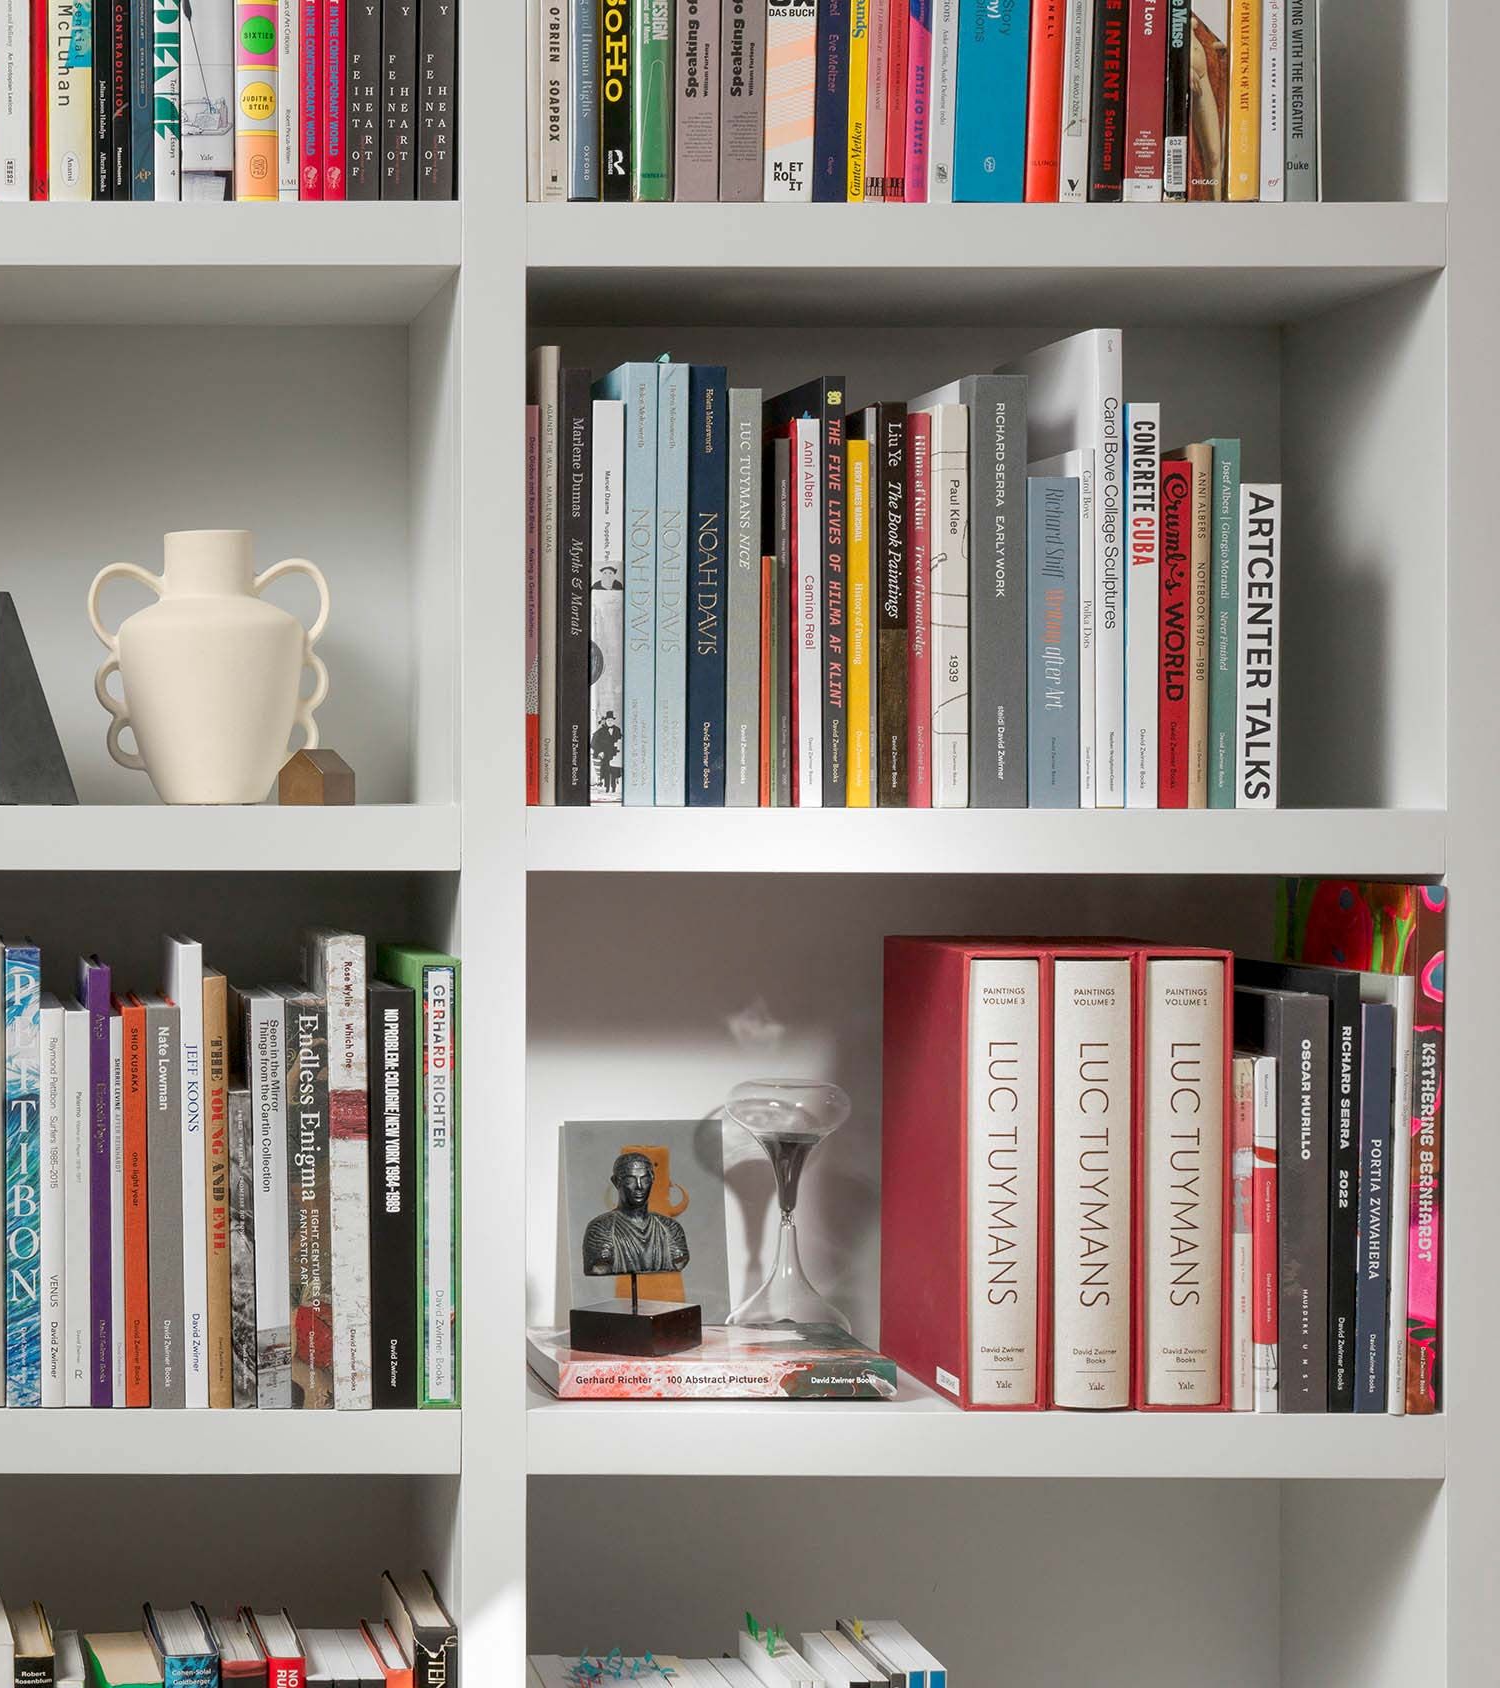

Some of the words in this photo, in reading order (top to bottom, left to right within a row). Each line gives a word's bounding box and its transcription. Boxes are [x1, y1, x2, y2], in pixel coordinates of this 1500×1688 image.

[549, 7, 561, 63] O'BRIEN
[1172, 8, 1185, 48] Muse
[1292, 29, 1303, 58] WITH
[57, 5, 72, 106] McLuhan
[115, 5, 124, 117] CONTRADICTION
[1103, 21, 1119, 101] INTENT
[1292, 61, 1303, 82] THE
[549, 79, 561, 142] SOAPBOX
[1291, 85, 1303, 139] NEGATIVE
[1102, 109, 1116, 171] Suleiman
[1286, 161, 1309, 170] Duke
[65, 156, 76, 182] Anansi
[571, 418, 585, 469] Marlene
[739, 422, 750, 451] LUC
[828, 419, 841, 446] THE
[888, 422, 902, 440] Liu
[994, 402, 1005, 462] RICHARD
[1103, 397, 1119, 439] Carol
[828, 455, 841, 492] FIVE
[888, 443, 902, 467] Ye
[1103, 442, 1119, 482] Bove
[1132, 420, 1157, 513] CONCRETE
[571, 473, 585, 517] Dumas
[738, 455, 750, 528] TUYMANS
[994, 464, 1005, 507] SERRA
[828, 500, 841, 545] LIVES
[994, 516, 1005, 557] EARLY
[1102, 484, 1119, 544] Collage
[698, 512, 718, 587] NOAH
[738, 534, 750, 569] NICE
[828, 554, 841, 572] OF
[1132, 517, 1155, 566] CUBA
[828, 580, 841, 626] HILMA
[994, 558, 1005, 598] WORK
[1102, 546, 1119, 629] Sculptures
[1244, 491, 1275, 689] ARTCENTER
[698, 593, 718, 656] DAVIS
[828, 634, 841, 654] AF
[828, 662, 841, 708] KLINT
[1243, 697, 1272, 800] TALKS
[157, 1026, 170, 1055] Nate
[432, 984, 446, 1069] GERHARD
[157, 1059, 170, 1110] Lowman
[184, 1043, 199, 1076] JEFF
[298, 1013, 320, 1105] Endless
[988, 1041, 1019, 1112] LUC
[1079, 1043, 1110, 1114] LUC
[1169, 1042, 1201, 1115] LUC
[1300, 1039, 1312, 1090] OSCAR
[186, 1080, 200, 1132] KOONS
[432, 1074, 446, 1149] RICHTER
[1420, 1042, 1436, 1146] KATHERINE
[1300, 1093, 1312, 1160] MURILLO
[294, 1111, 321, 1201] Enigma
[987, 1126, 1019, 1306] TUYMANS
[1078, 1127, 1110, 1308] TUYMANS
[1168, 1127, 1201, 1306] TUYMANS
[1417, 1150, 1435, 1261] BERNHARDT
[576, 1375, 615, 1385] Gerhard
[618, 1375, 653, 1384] Richter
[666, 1375, 683, 1384] 100
[685, 1375, 726, 1384] Abstract
[729, 1375, 769, 1384] Pictures
